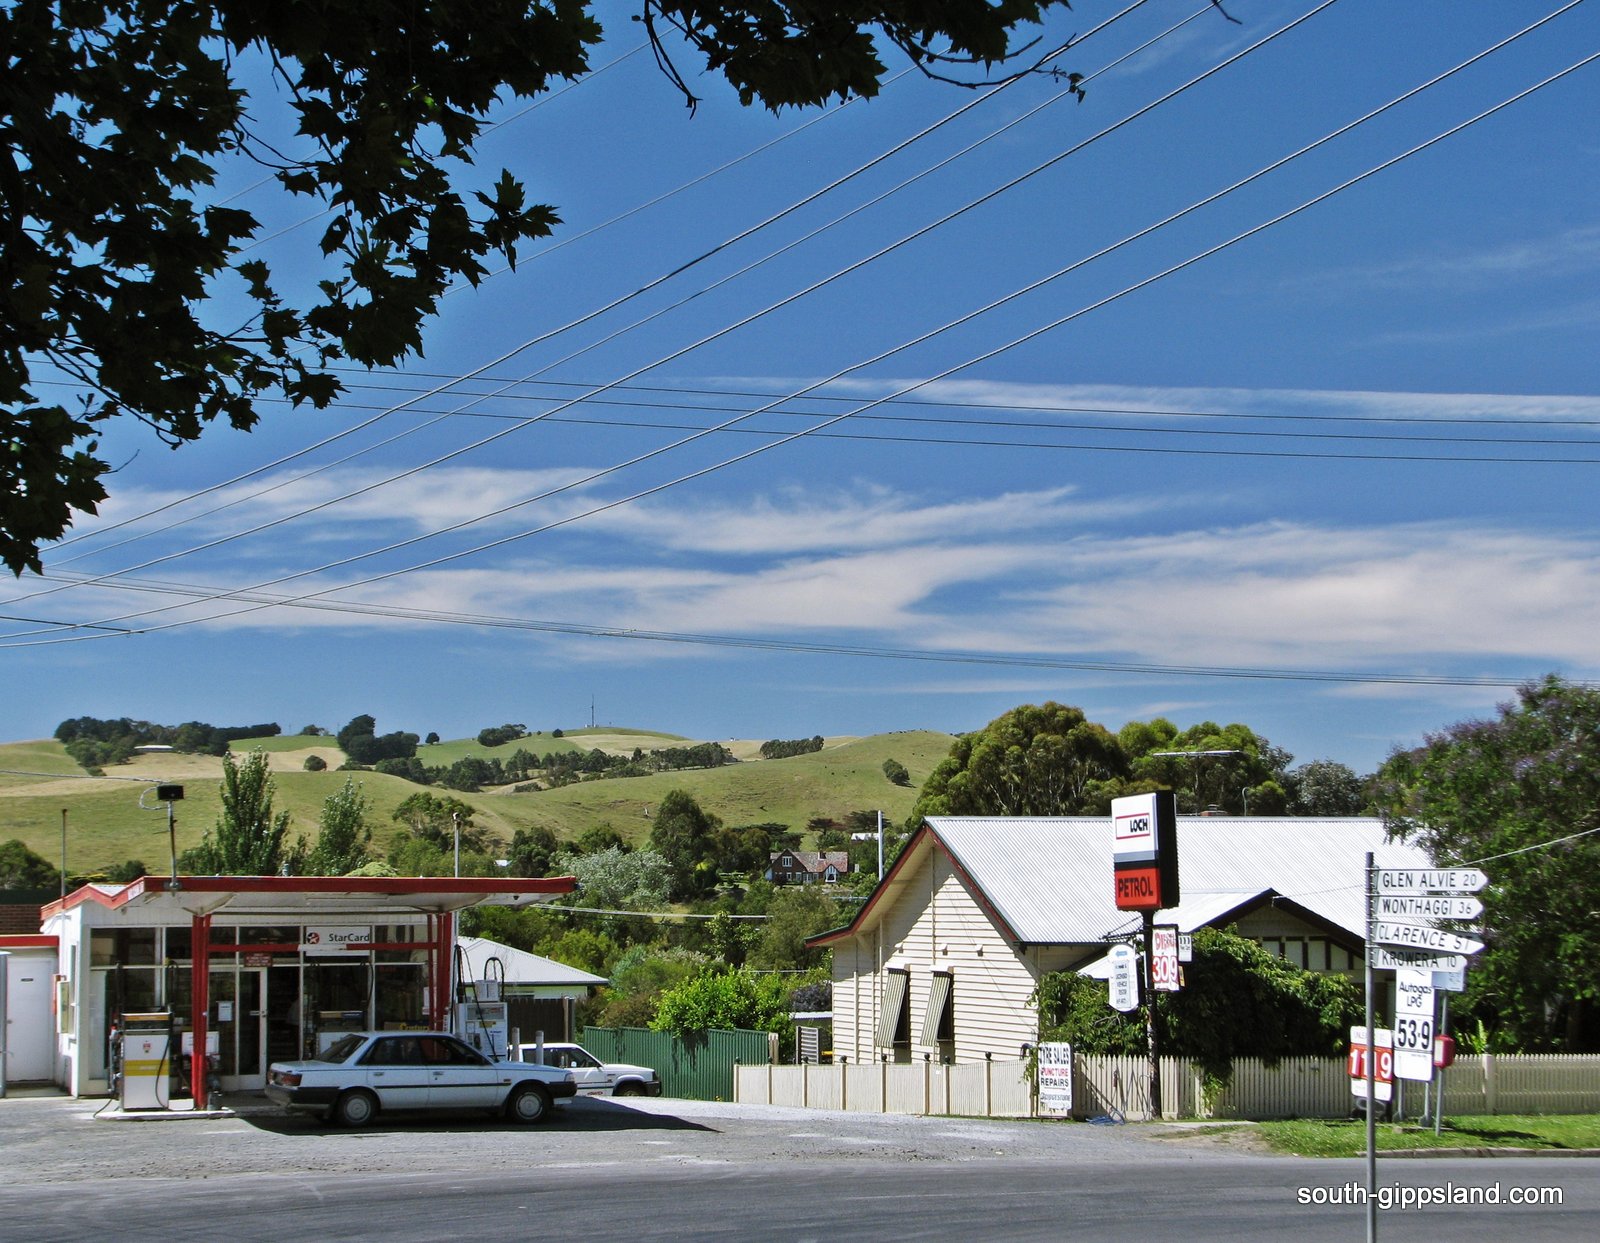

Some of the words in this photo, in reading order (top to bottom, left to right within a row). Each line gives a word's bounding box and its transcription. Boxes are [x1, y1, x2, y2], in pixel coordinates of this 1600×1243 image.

[1130, 818, 1148, 833] LOCH
[1118, 876, 1154, 898] PETROL
[1382, 872, 1413, 888] GLEN
[1420, 872, 1456, 888] ALVIE
[1463, 873, 1477, 887] 20
[1382, 899, 1452, 916] WONTHAGGI
[1458, 901, 1472, 914] 36
[328, 933, 370, 942] StarCard
[1379, 925, 1448, 947] CLARENCE
[1382, 951, 1439, 968] KROWERA
[1446, 956, 1457, 968] 10
[1399, 981, 1432, 997] Autogas
[1406, 996, 1422, 1008] LPG
[1040, 1067, 1069, 1078] PUNCTURE
[1040, 1078, 1069, 1088] REPAIRS
